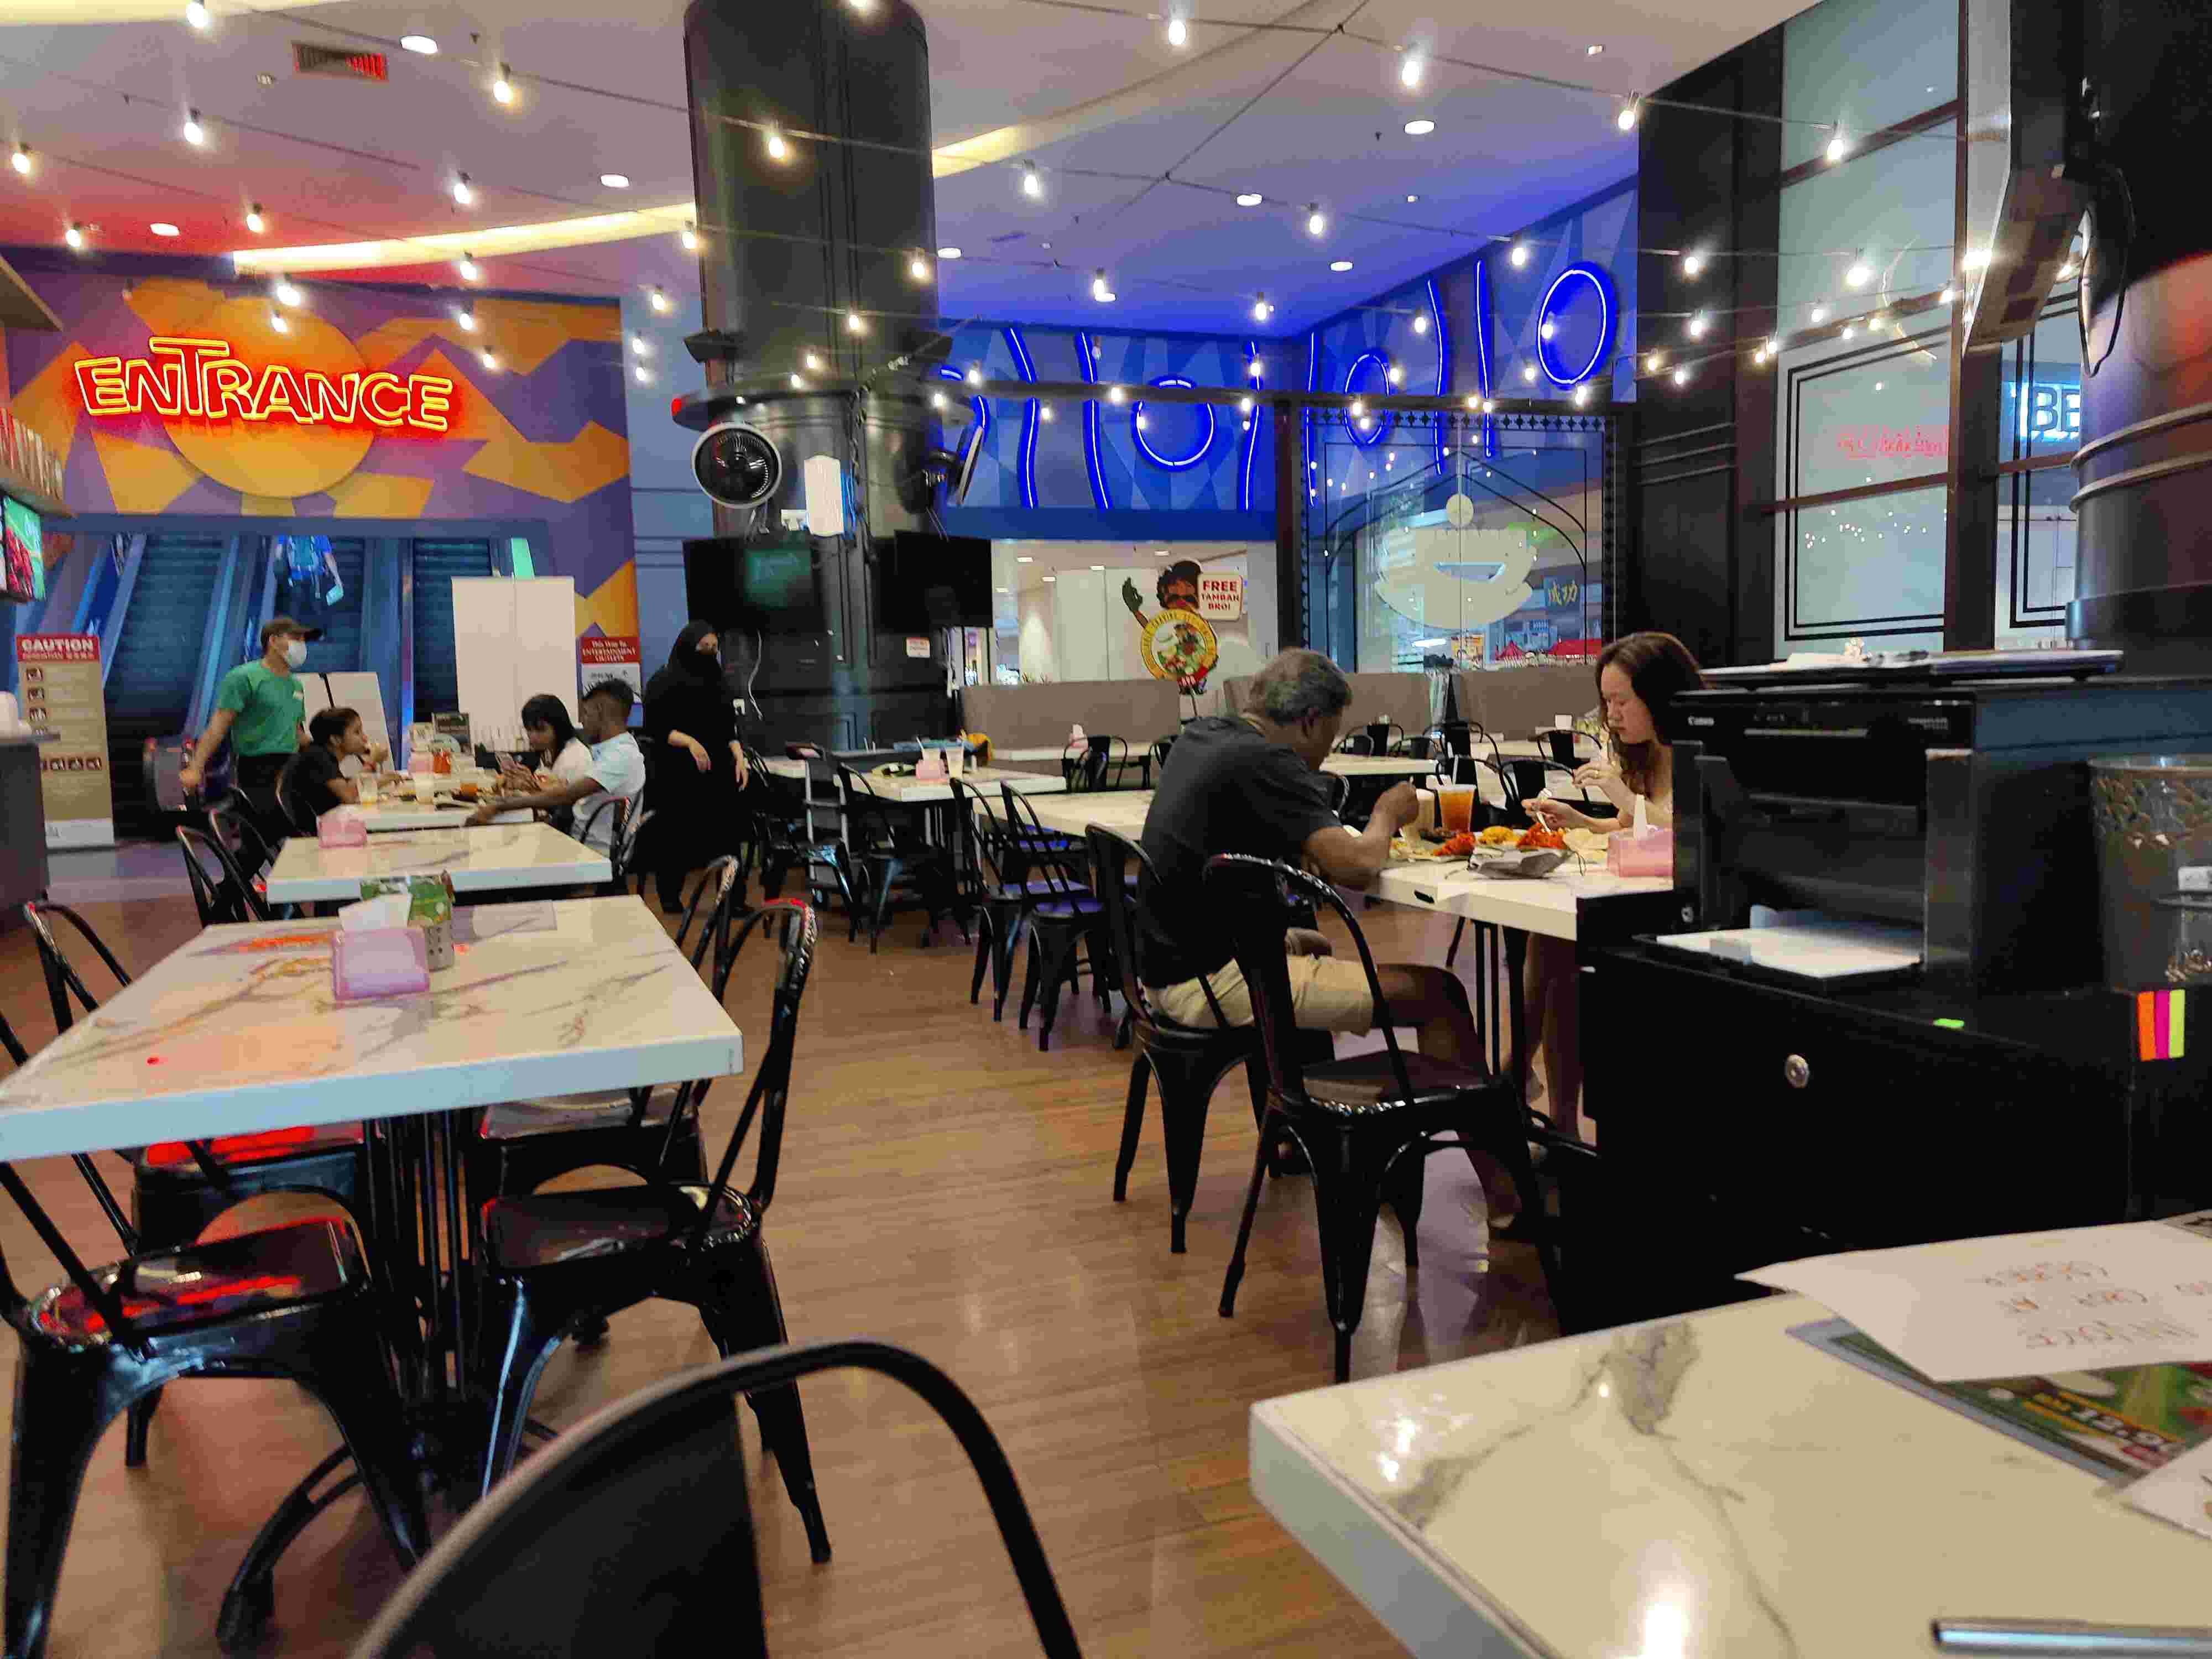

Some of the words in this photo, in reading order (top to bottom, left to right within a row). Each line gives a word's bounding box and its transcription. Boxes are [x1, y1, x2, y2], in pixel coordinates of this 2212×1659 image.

[74, 336, 453, 432] ENTRANCE
[1203, 580, 1237, 592] FREE
[22, 638, 93, 651] CAUTION
[582, 646, 637, 656] ENTERTAINMENT
[1688, 716, 1714, 726] Canon
